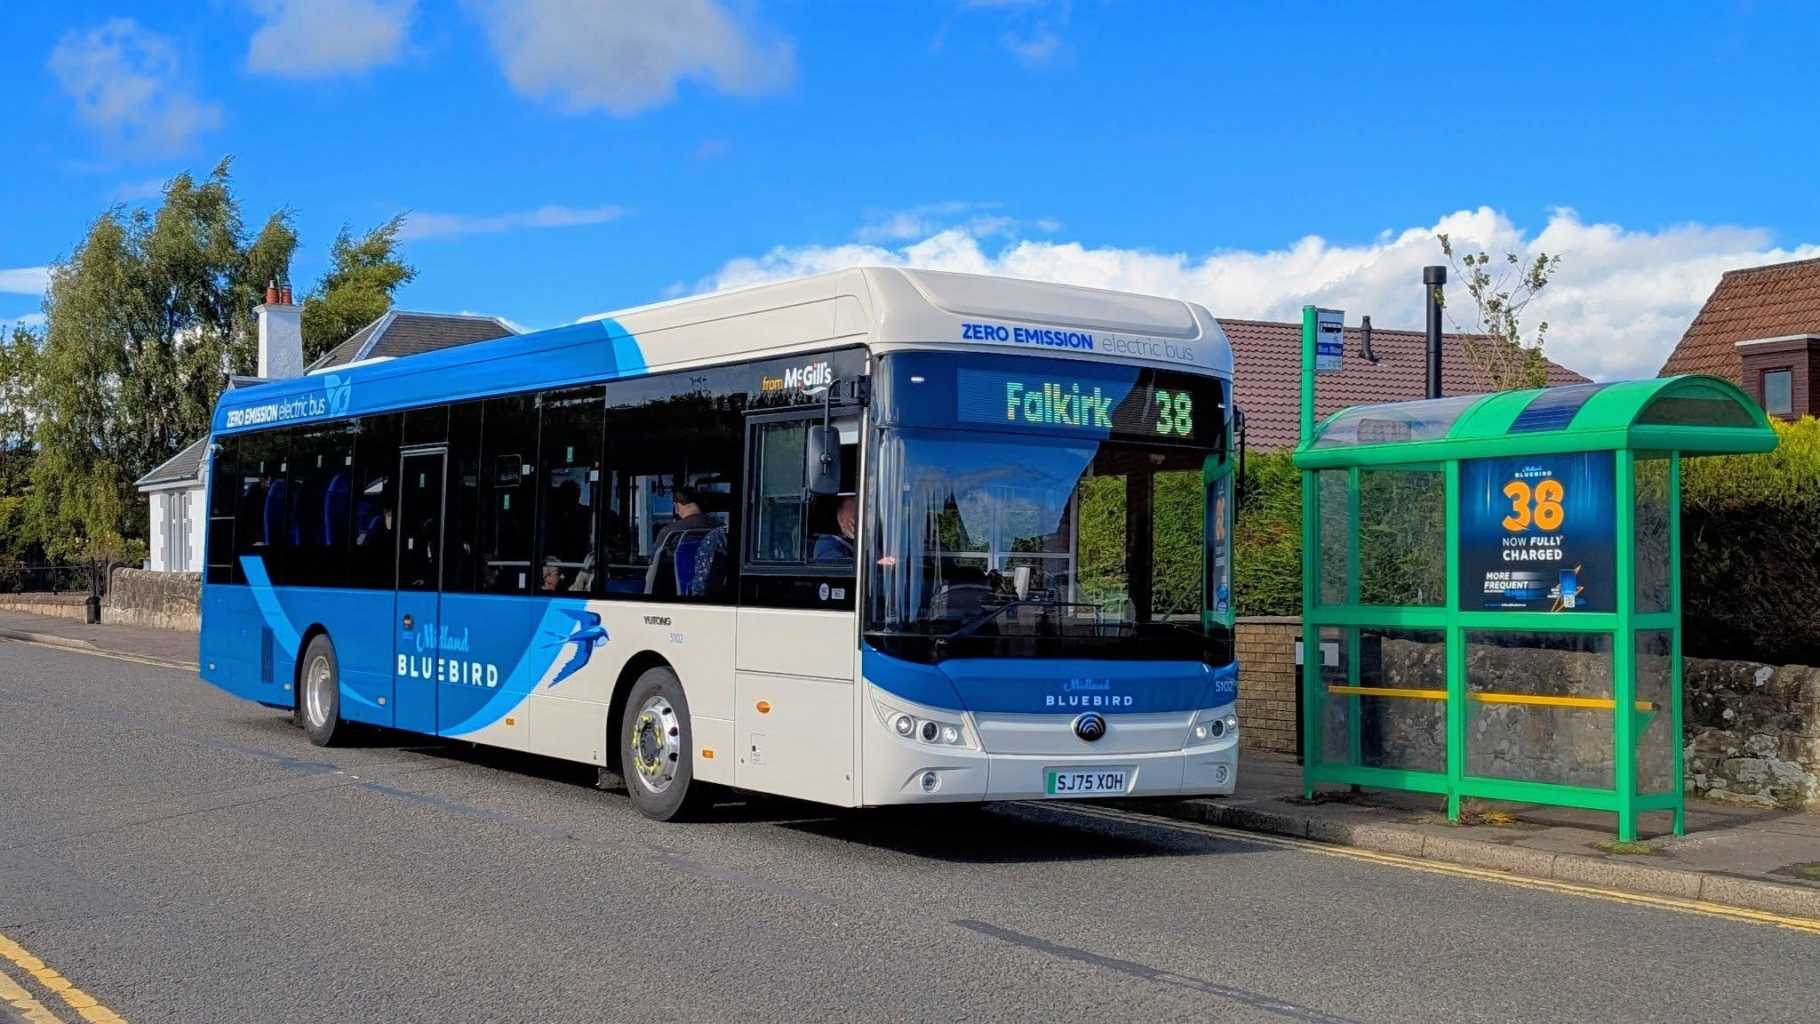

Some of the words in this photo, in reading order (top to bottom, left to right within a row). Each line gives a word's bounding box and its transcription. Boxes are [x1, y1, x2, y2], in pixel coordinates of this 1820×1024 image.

[961, 324, 1009, 342] ZERO
[1014, 328, 1094, 350] EMISSION
[1102, 335, 1163, 358] electric
[1165, 338, 1195, 362] bus
[762, 376, 783, 391] from
[784, 360, 832, 389] McGill's
[226, 409, 244, 428] ZERO
[244, 403, 278, 425] EMISSION
[279, 395, 308, 419] electric
[309, 393, 326, 416] bus
[1006, 382, 1113, 428] Falkirk
[1155, 390, 1193, 437] 38
[1502, 479, 1565, 532] 38
[1502, 537, 1527, 547] NOW
[1530, 536, 1562, 547] FULLY
[1502, 550, 1563, 561] CHARGED
[1483, 581, 1528, 589] FREQUENT
[1486, 571, 1510, 580] MORE
[643, 615, 672, 626] YUTONG
[416, 623, 470, 652] Midland
[397, 653, 499, 688] BLUEBIRD
[1045, 695, 1133, 706] BLUEBIRD
[1057, 774, 1093, 790] SJ75
[1096, 773, 1124, 790] XOH
